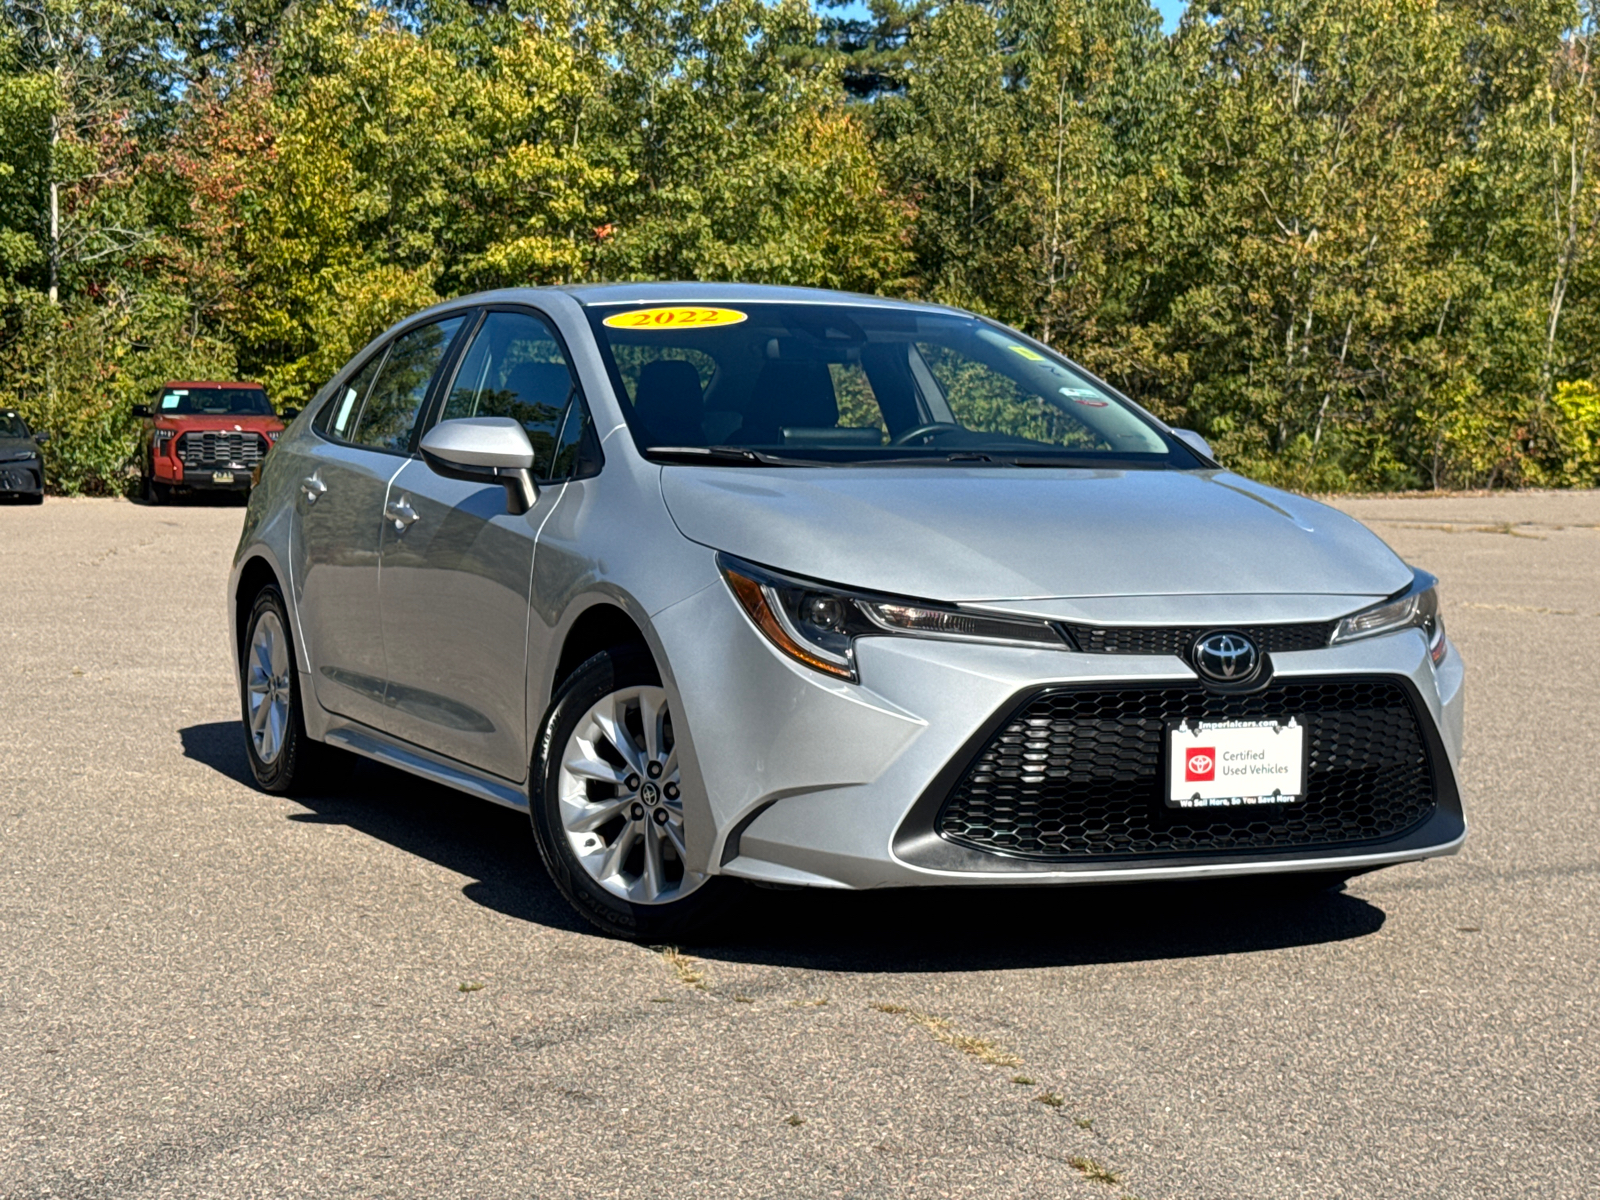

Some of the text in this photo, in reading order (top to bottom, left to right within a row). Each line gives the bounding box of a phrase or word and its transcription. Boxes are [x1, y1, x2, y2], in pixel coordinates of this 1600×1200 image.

[632, 310, 719, 326] 2022
[1222, 749, 1265, 761] Certified
[1222, 763, 1289, 776] Used Vehicles
[1180, 799, 1193, 807] We
[1231, 797, 1242, 805] So
[1243, 797, 1257, 805] You
[1258, 796, 1276, 804] Save
[1277, 795, 1295, 803] More
